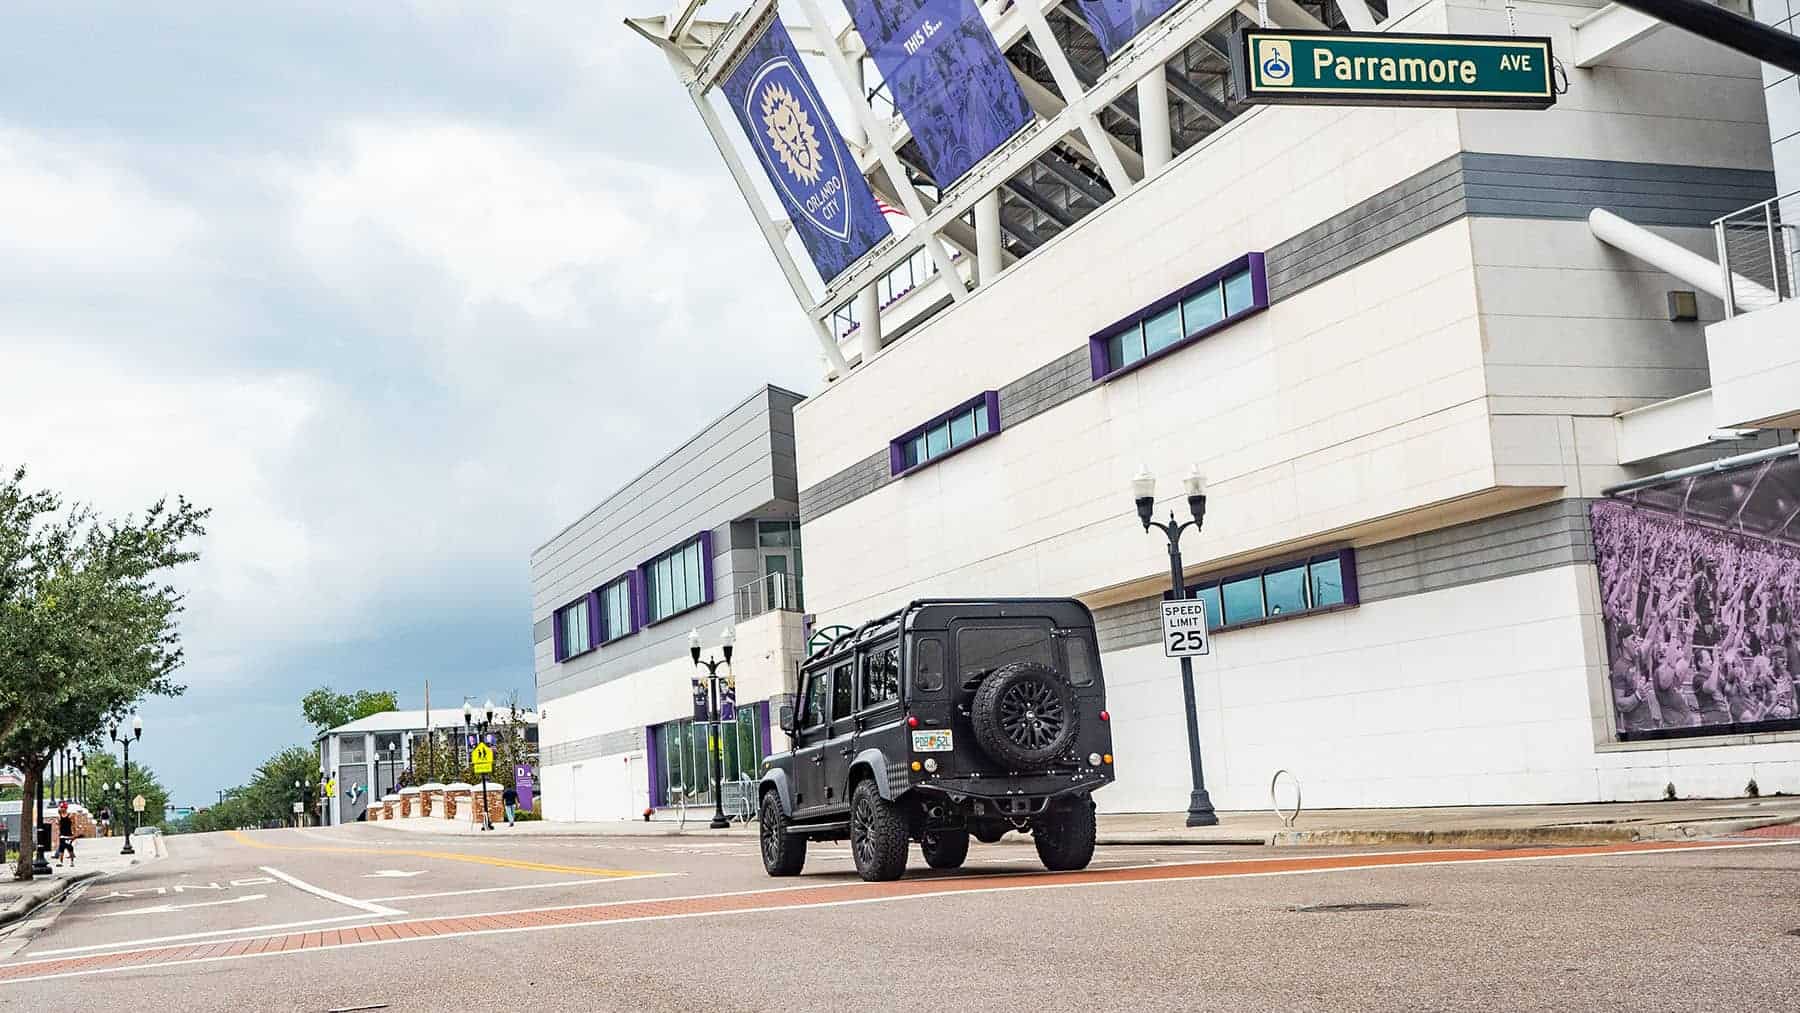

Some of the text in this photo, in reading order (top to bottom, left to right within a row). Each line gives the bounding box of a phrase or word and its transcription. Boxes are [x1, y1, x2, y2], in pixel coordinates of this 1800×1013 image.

[904, 29, 925, 56] THIS
[1312, 47, 1532, 84] Parramore AVE
[806, 175, 841, 213] ORLANDO
[822, 197, 840, 220] CITY
[1165, 605, 1202, 616] SPEED
[1170, 617, 1198, 628] LIMIT
[1170, 630, 1203, 651] 25
